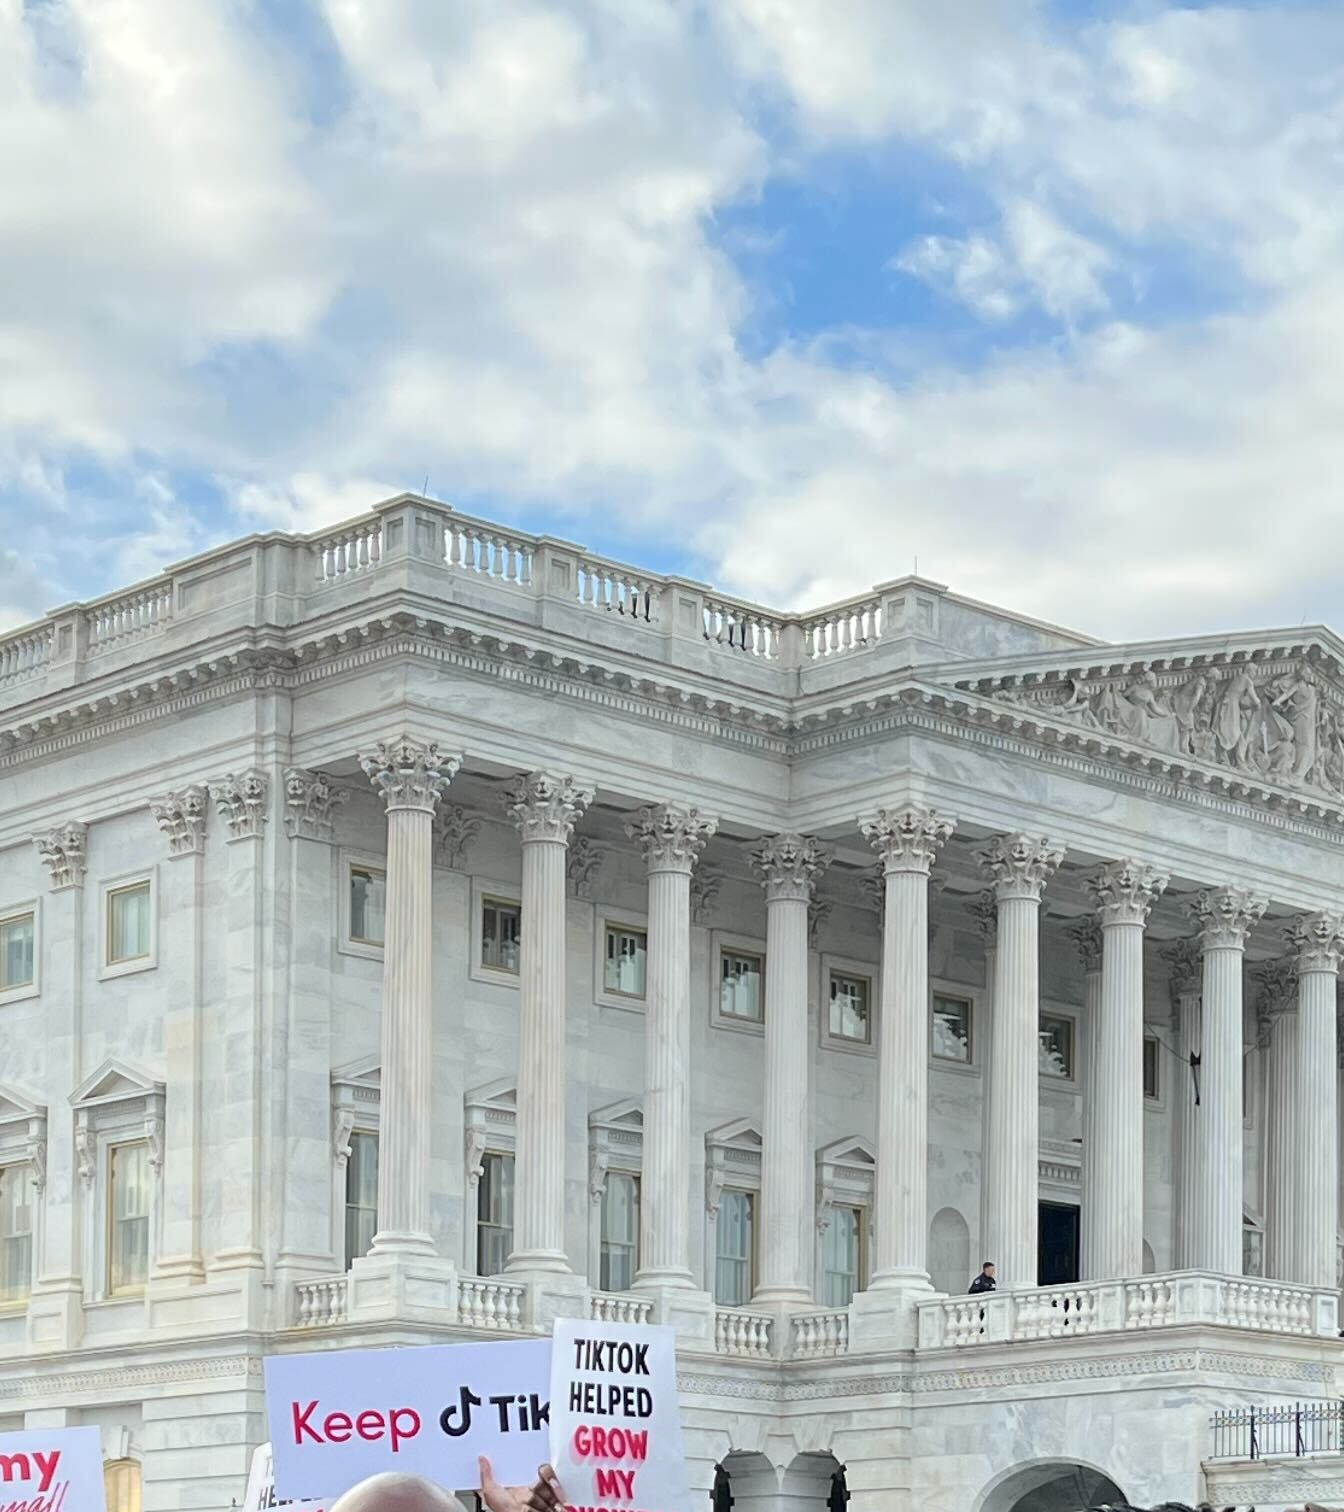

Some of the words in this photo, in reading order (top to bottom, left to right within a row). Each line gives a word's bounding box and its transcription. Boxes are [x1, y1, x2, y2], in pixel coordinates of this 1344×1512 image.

[573, 1338, 650, 1376] TIKTOK
[569, 1381, 654, 1418] HELPED
[291, 1400, 421, 1453] Keep
[574, 1424, 648, 1461] GROW
[595, 1468, 636, 1500] MY
